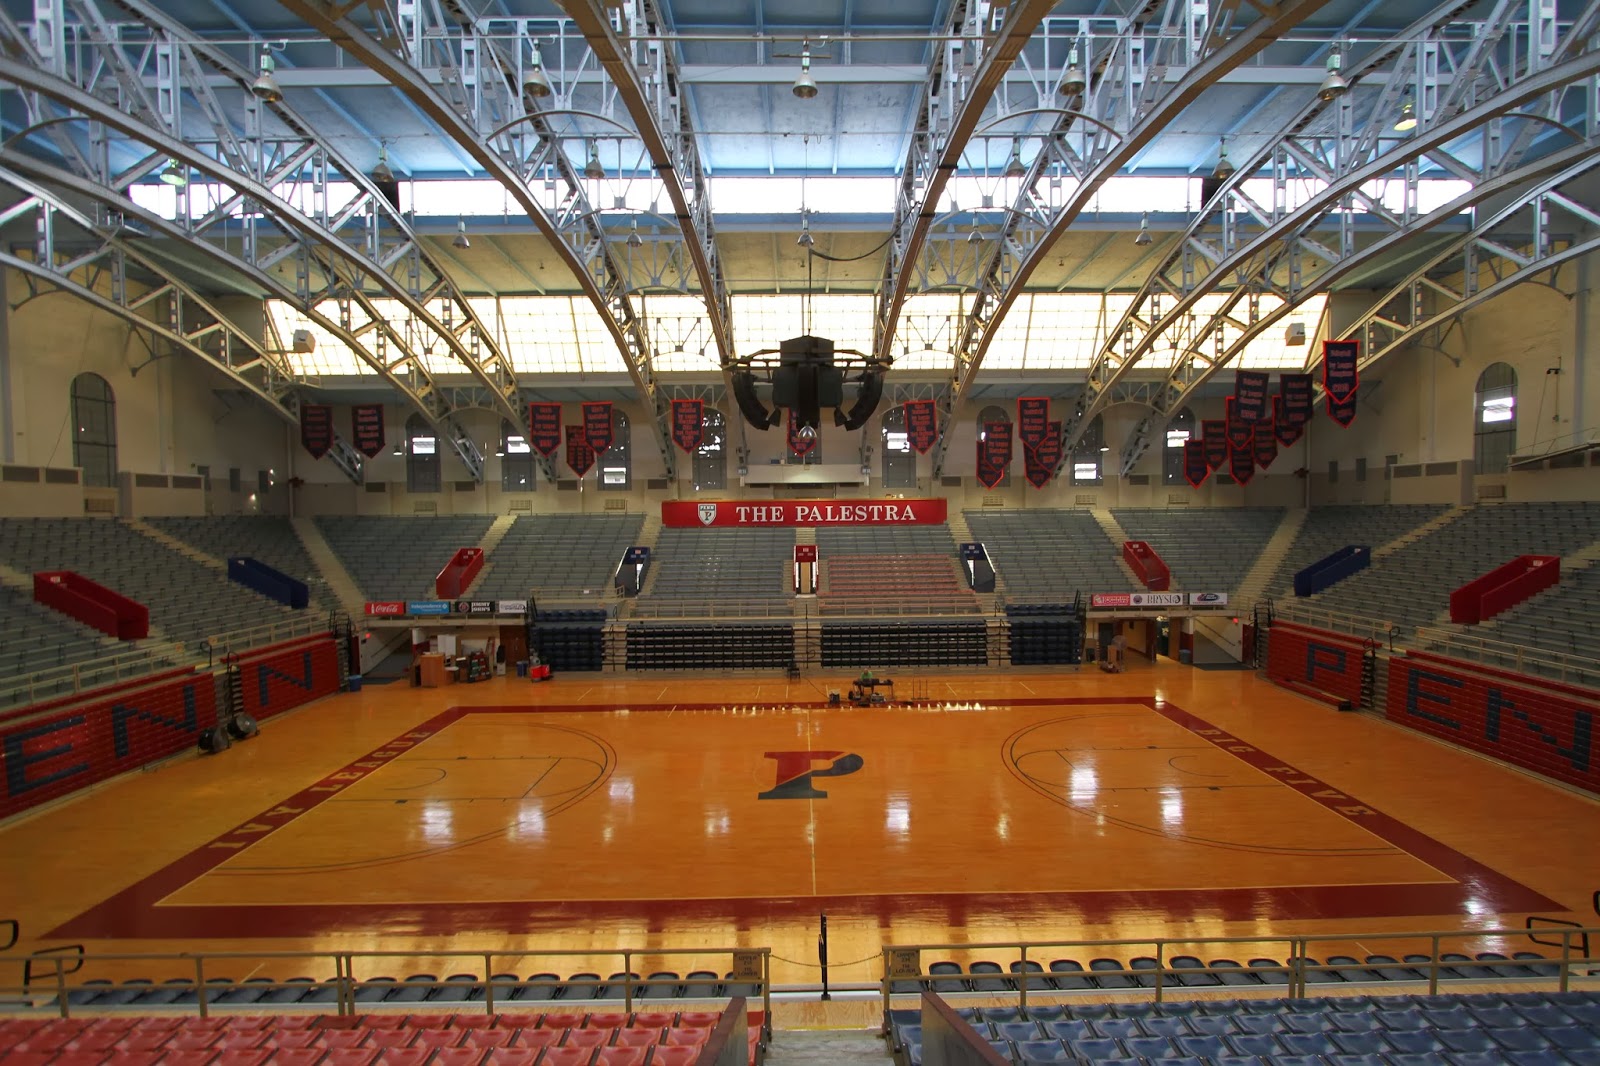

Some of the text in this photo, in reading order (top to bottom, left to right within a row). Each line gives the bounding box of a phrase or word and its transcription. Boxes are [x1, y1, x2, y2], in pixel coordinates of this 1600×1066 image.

[736, 505, 917, 522] THE PALESTRA
[208, 730, 431, 849] IVY LEAGUE
[1195, 728, 1377, 816] BIG FIVE
